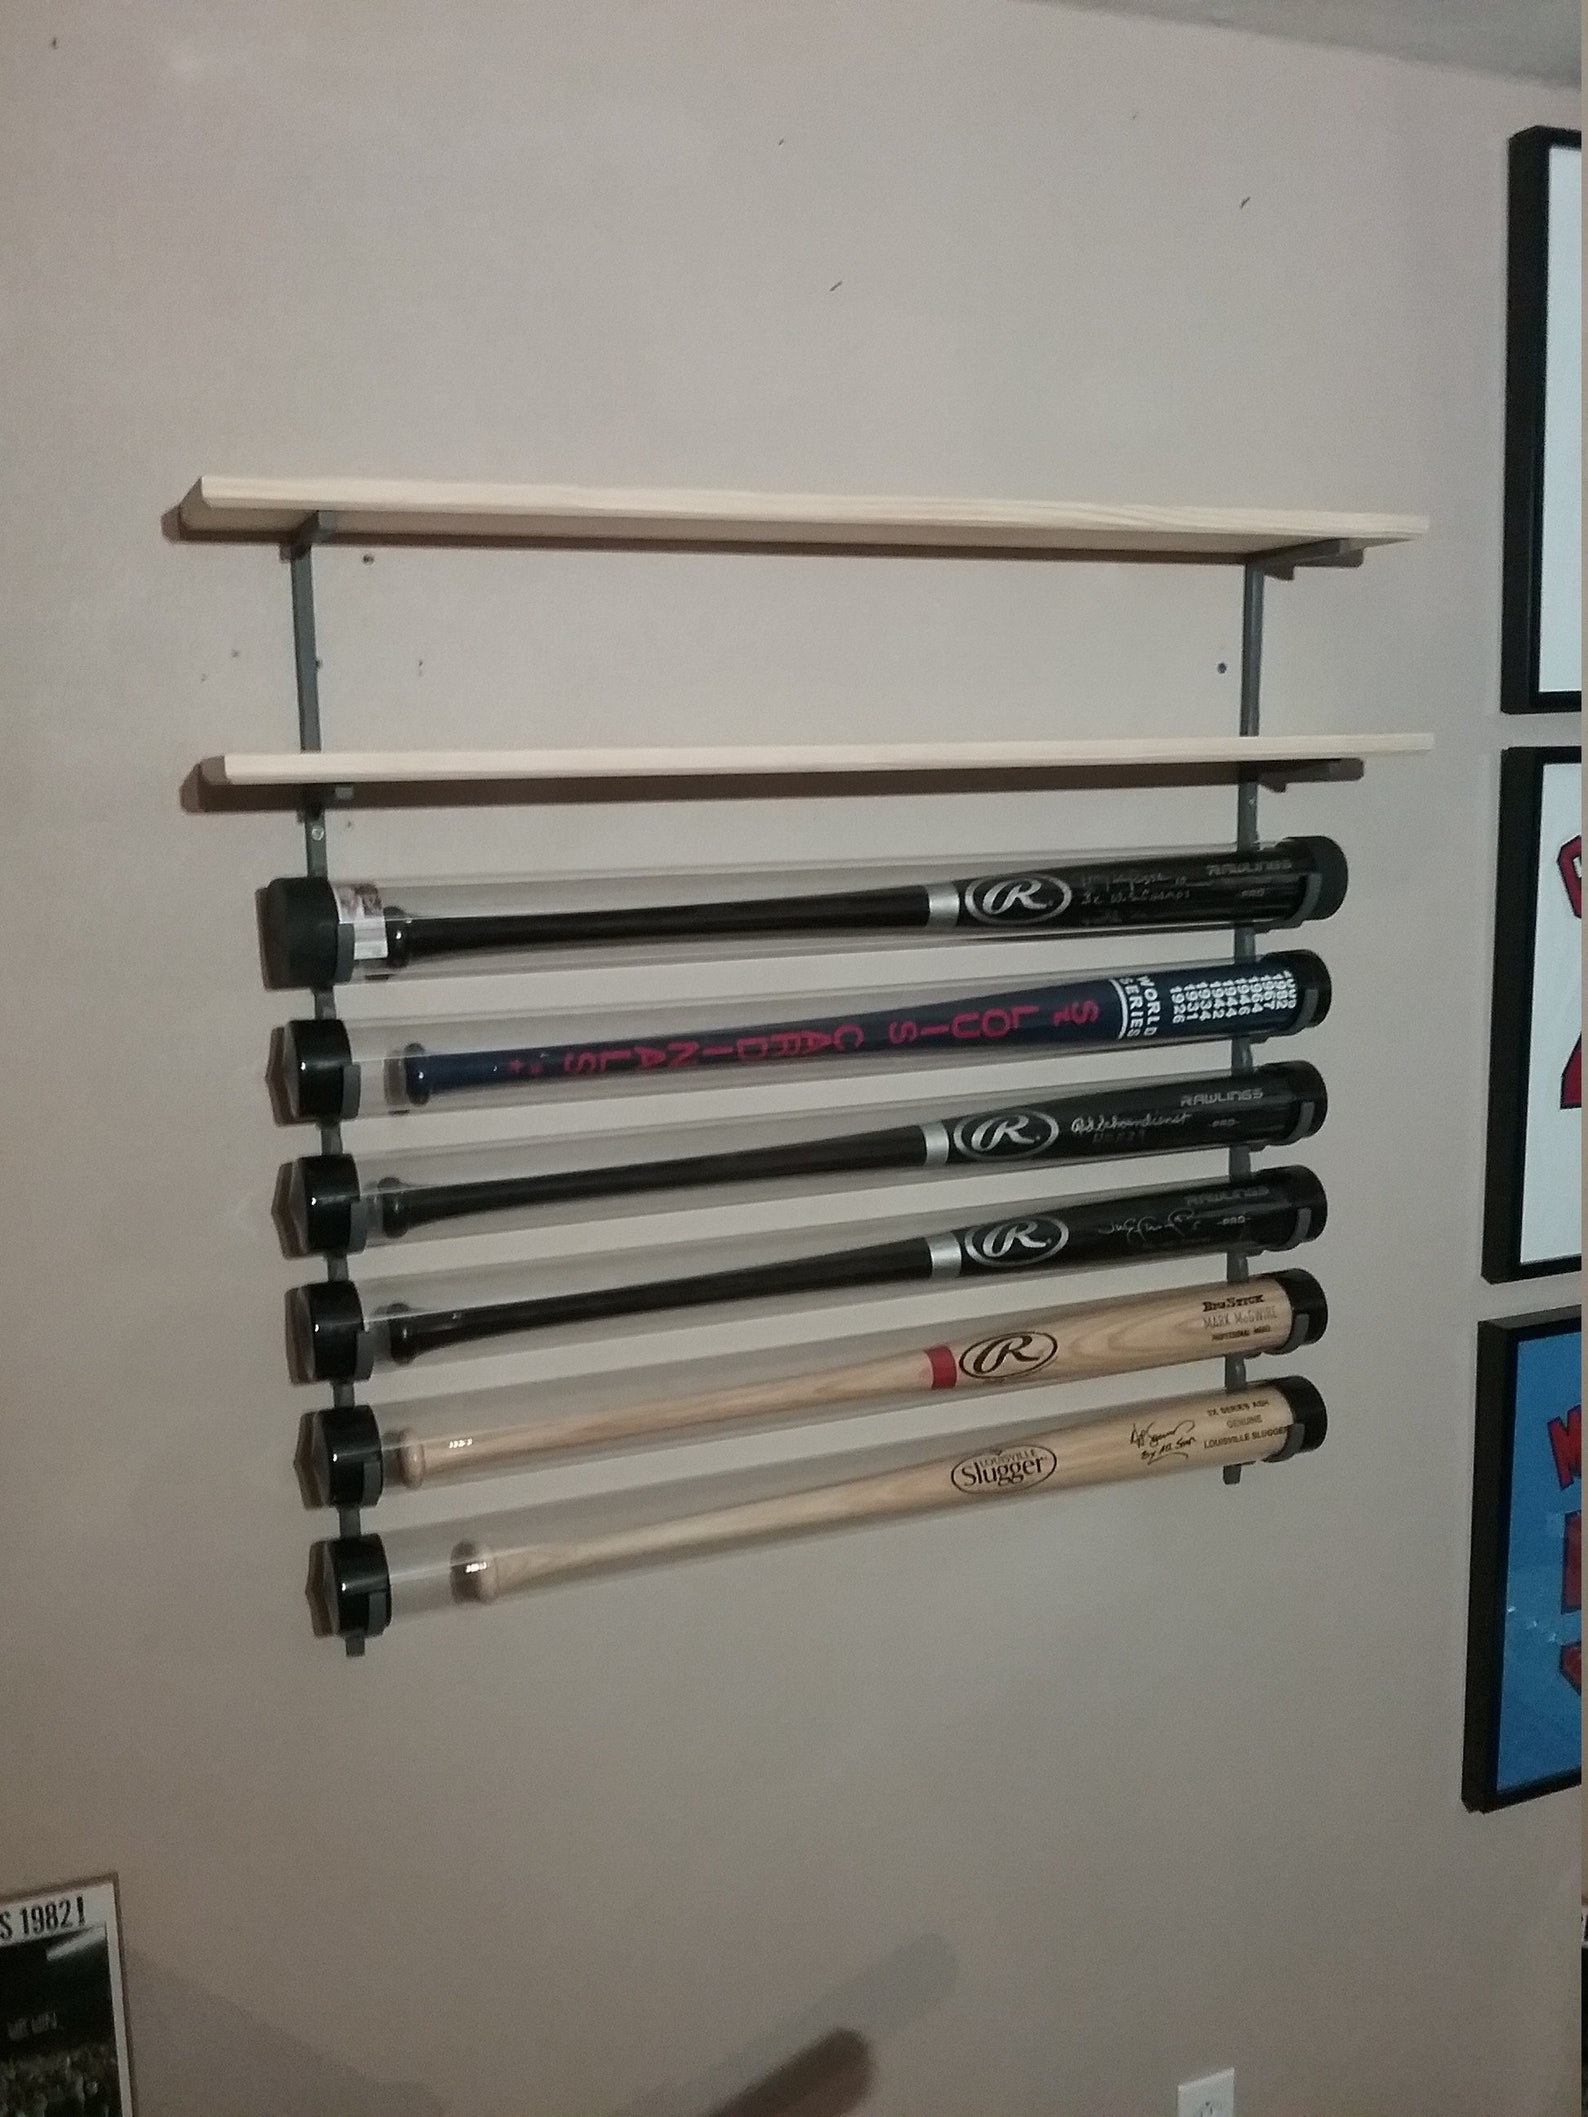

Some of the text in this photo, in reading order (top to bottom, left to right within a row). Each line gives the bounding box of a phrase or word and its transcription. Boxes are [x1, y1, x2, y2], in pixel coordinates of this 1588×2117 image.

[1119, 977, 1144, 1038] SERIES
[1137, 975, 1161, 1037] WORLD
[1170, 985, 1186, 1024] 1926
[1184, 983, 1199, 1021] 1931
[1197, 981, 1212, 1021] 1934
[1210, 980, 1225, 1019] 1942
[1223, 979, 1238, 1018] 1944
[1235, 977, 1251, 1016] 1946
[1248, 975, 1264, 1013] 1964
[1260, 974, 1276, 1010] 1967
[1272, 972, 1289, 1010] 1982
[1180, 1087, 1264, 1107] RAWLINGS
[1203, 1433, 1250, 1449] LOUISVILLE
[961, 1456, 1044, 1487] Slugger
